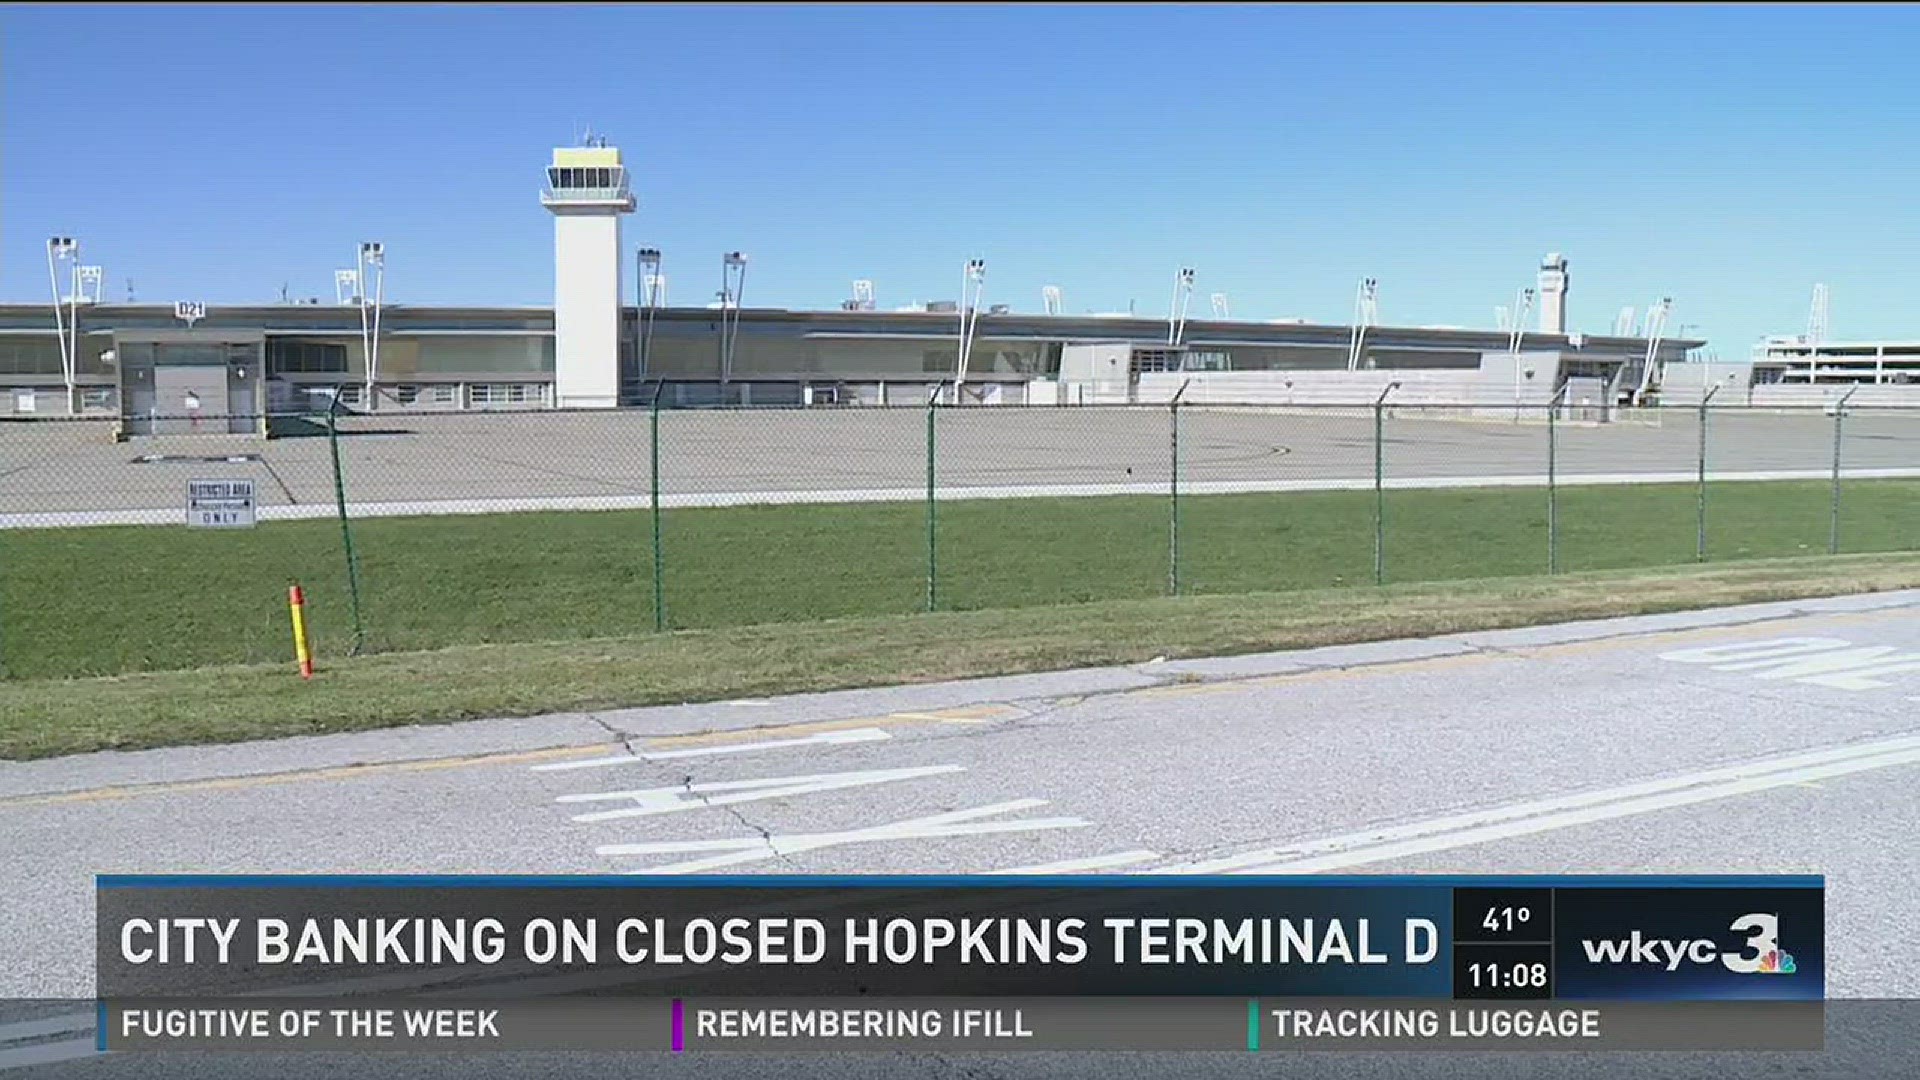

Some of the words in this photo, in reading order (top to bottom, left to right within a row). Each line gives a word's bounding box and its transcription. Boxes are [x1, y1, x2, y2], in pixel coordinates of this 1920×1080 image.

[178, 301, 204, 315] D21
[232, 483, 251, 496] AREA
[202, 512, 238, 524] ONLY
